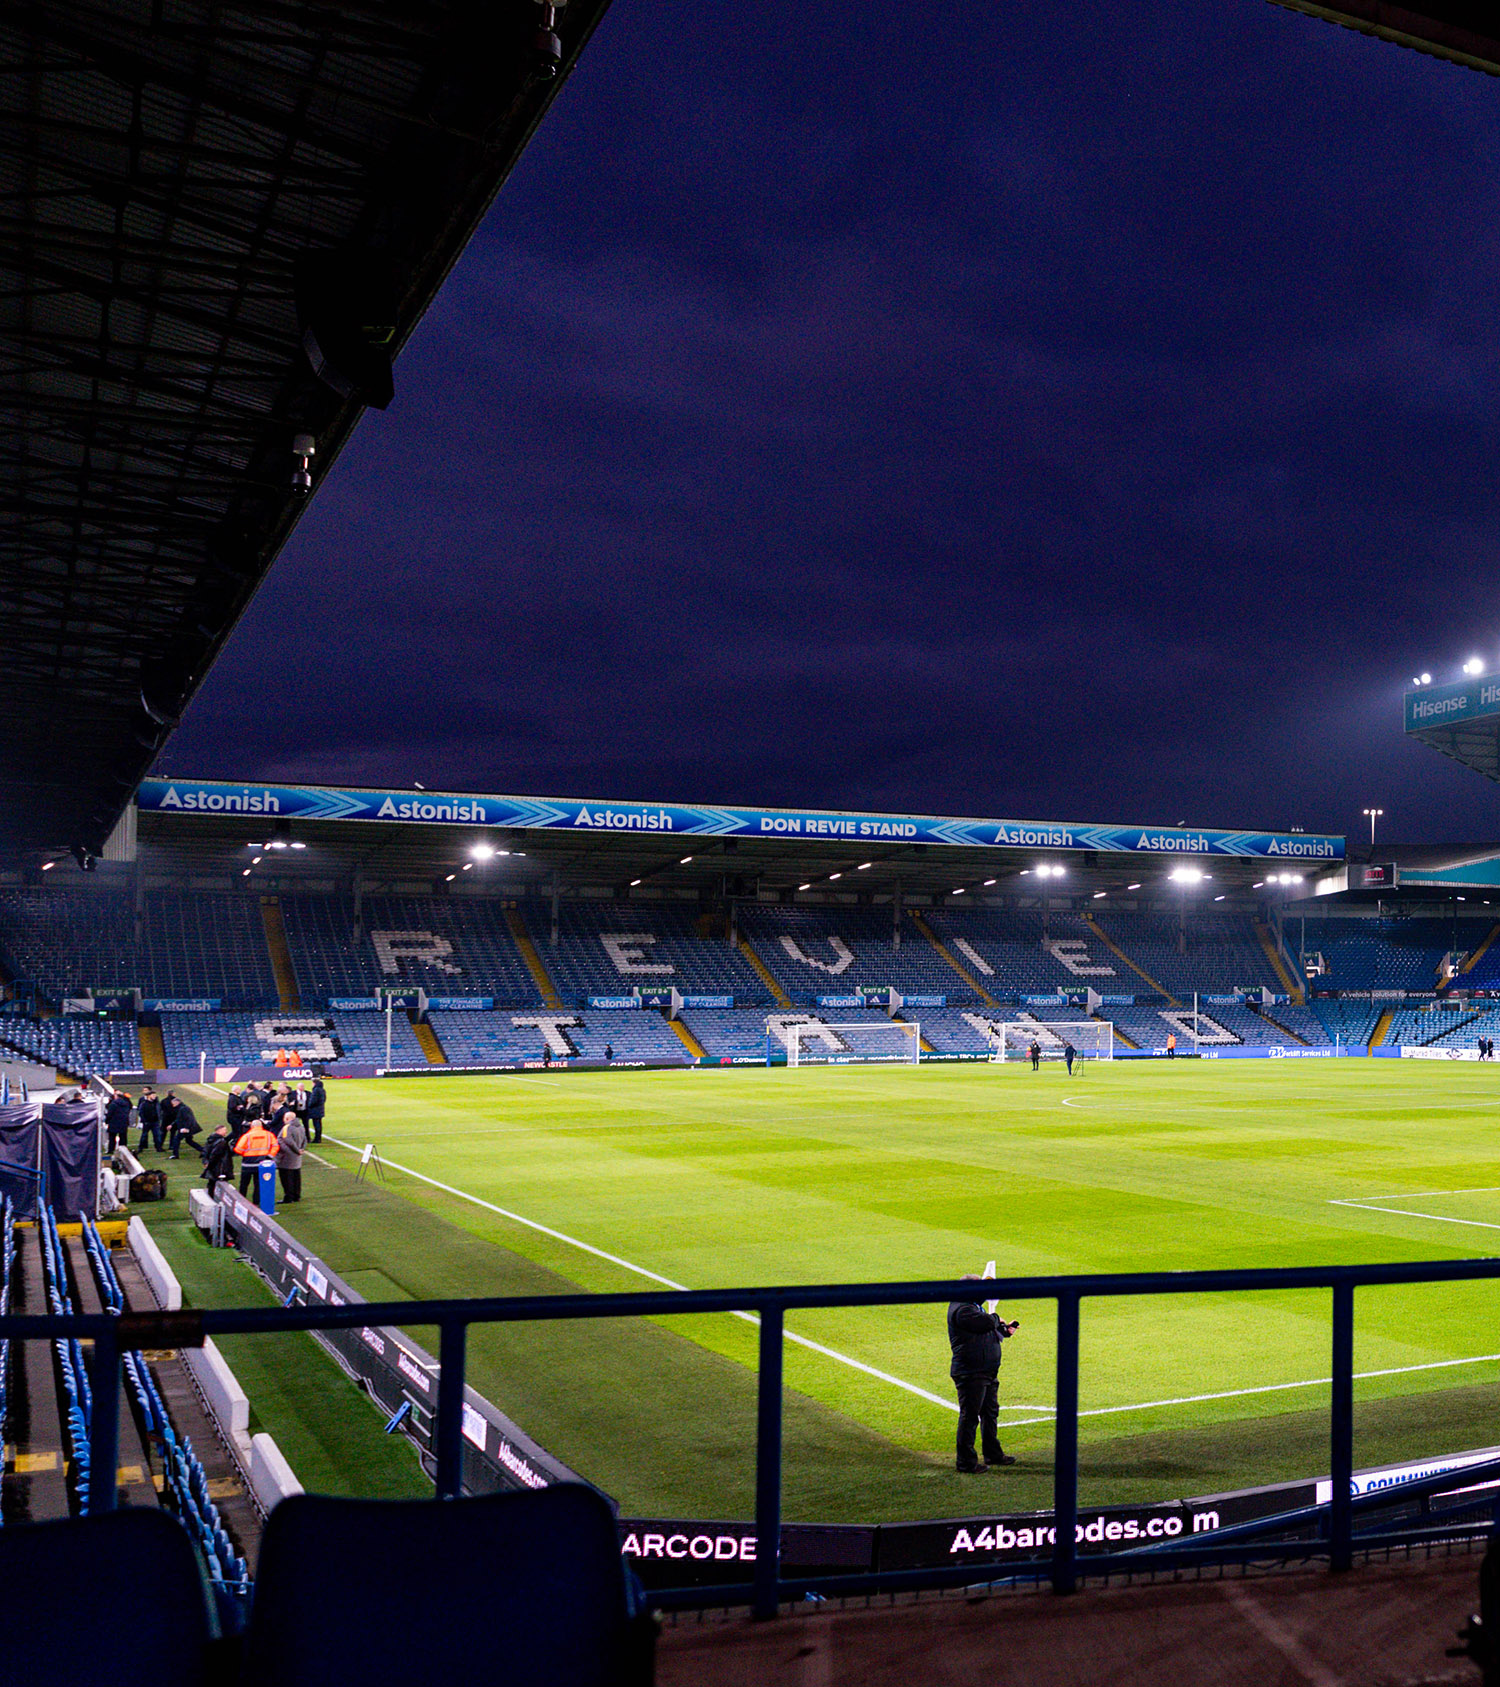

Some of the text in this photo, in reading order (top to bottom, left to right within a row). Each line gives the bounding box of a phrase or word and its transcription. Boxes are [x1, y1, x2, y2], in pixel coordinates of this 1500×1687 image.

[1413, 695, 1467, 719] Hisense
[160, 787, 280, 813] Astonish
[377, 796, 486, 822] Astonish
[574, 807, 673, 831] Astonish
[760, 816, 917, 837] DON REVIE STAND
[995, 825, 1073, 846] Astonish
[1136, 832, 1208, 852] Astonish
[1267, 837, 1334, 857] Astonish
[154, 1000, 211, 1011] Astonish
[331, 1000, 377, 1010] Astonish
[592, 999, 637, 1008] Astonish
[821, 998, 861, 1007] Astonish
[1026, 996, 1062, 1006] Astonish
[1207, 995, 1240, 1004] Astonish
[621, 1532, 760, 1561] ARCODE
